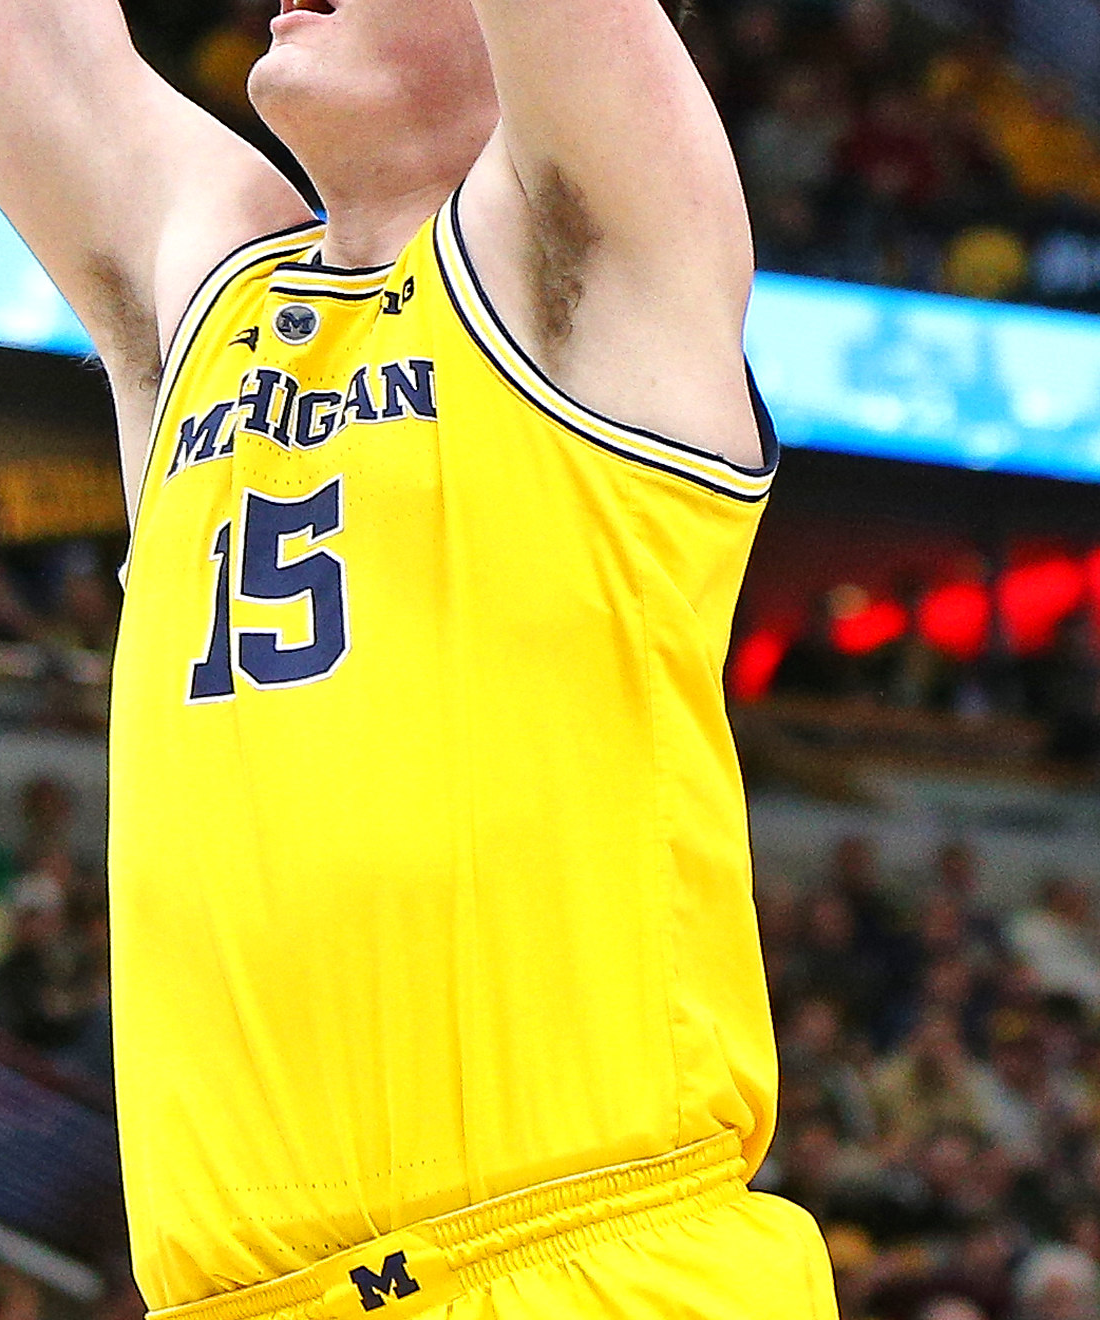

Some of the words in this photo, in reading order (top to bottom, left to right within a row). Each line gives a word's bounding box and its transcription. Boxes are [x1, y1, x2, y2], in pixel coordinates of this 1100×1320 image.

[278, 311, 315, 335] M
[166, 357, 438, 479] MHIGAN
[186, 476, 350, 703] 15
[348, 1250, 420, 1312] M
